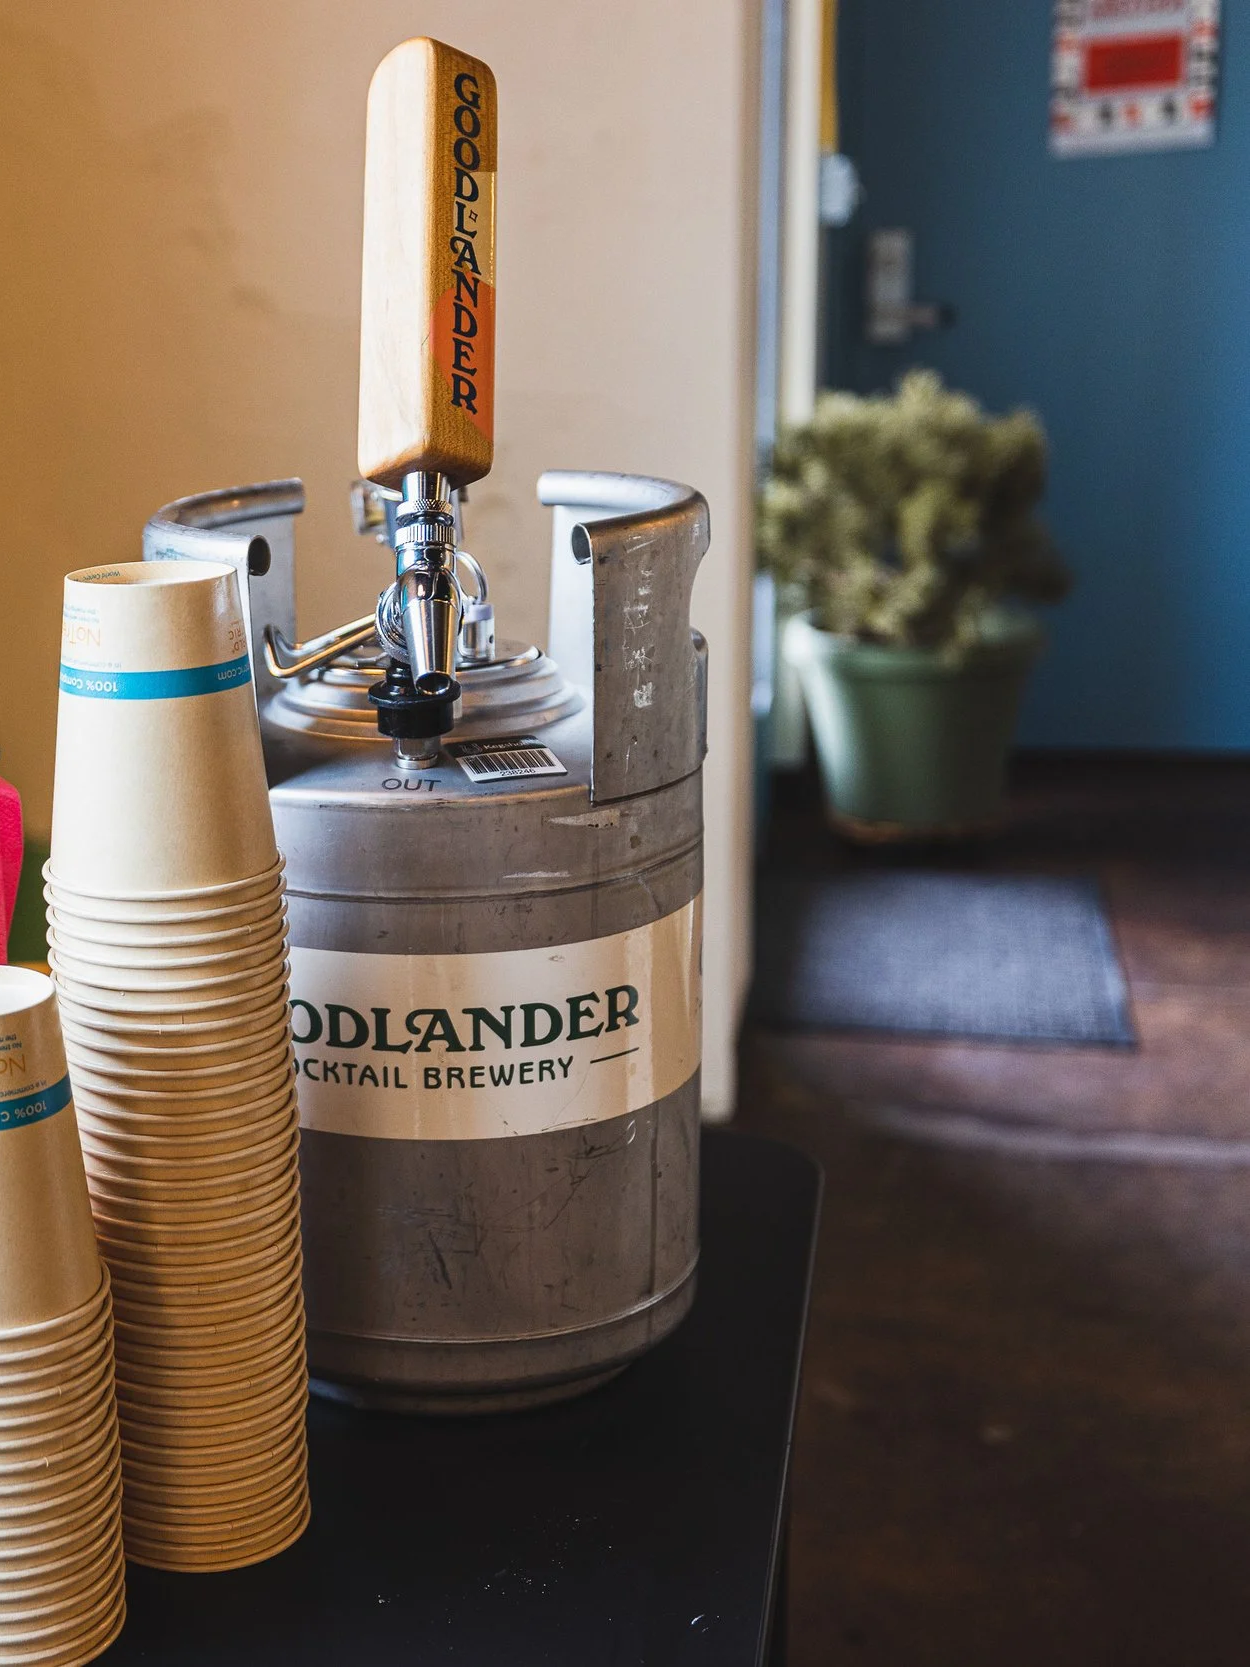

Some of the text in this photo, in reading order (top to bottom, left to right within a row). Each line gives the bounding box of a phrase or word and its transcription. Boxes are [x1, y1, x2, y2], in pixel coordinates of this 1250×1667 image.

[450, 72, 482, 416] GOODLANDER
[85, 680, 119, 693] 100%
[381, 778, 442, 792] OUT
[423, 1054, 574, 1090] BREWERY
[14, 1100, 48, 1119] 100%
